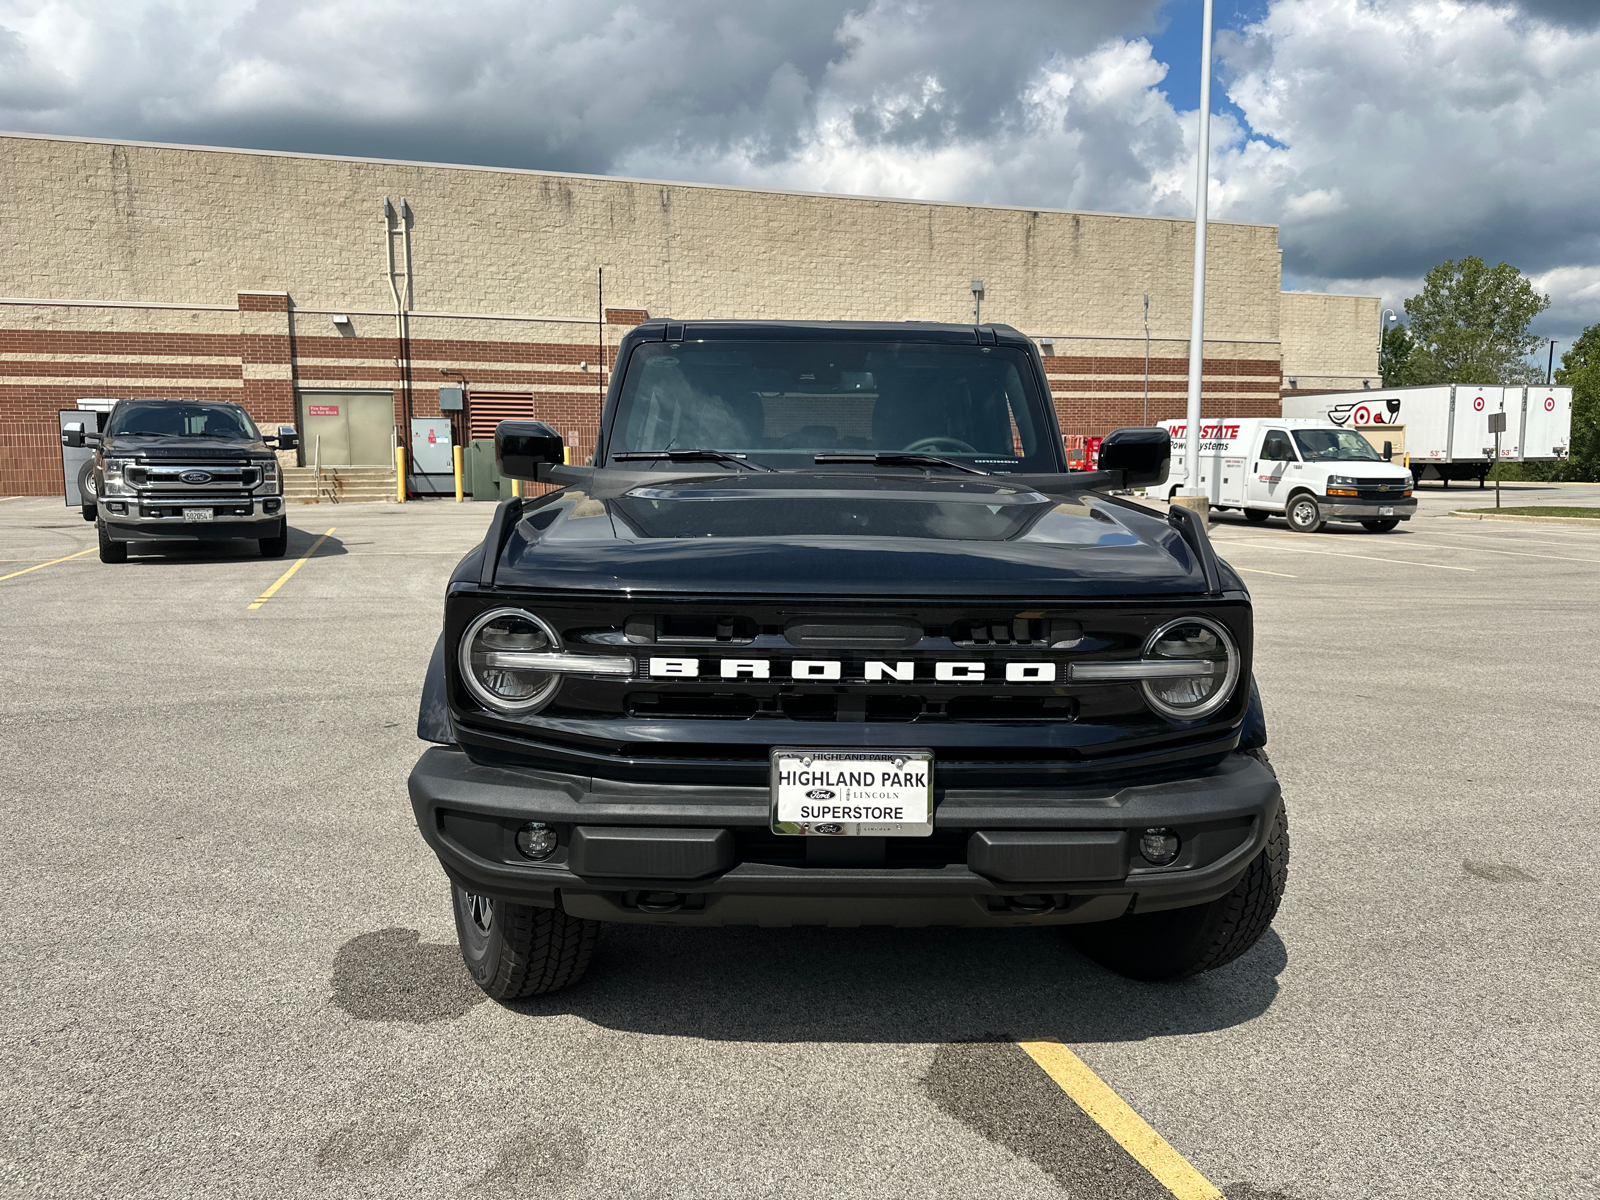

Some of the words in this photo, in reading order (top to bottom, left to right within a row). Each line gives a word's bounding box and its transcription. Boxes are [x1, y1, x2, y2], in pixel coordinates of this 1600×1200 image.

[1168, 425, 1240, 438] INTSTATE
[1199, 441, 1229, 451] ystems
[649, 657, 1056, 682] BRONCO
[779, 771, 875, 786] HIGHLAND
[882, 772, 926, 787] PARK
[800, 806, 904, 819] SUPERSTORE
